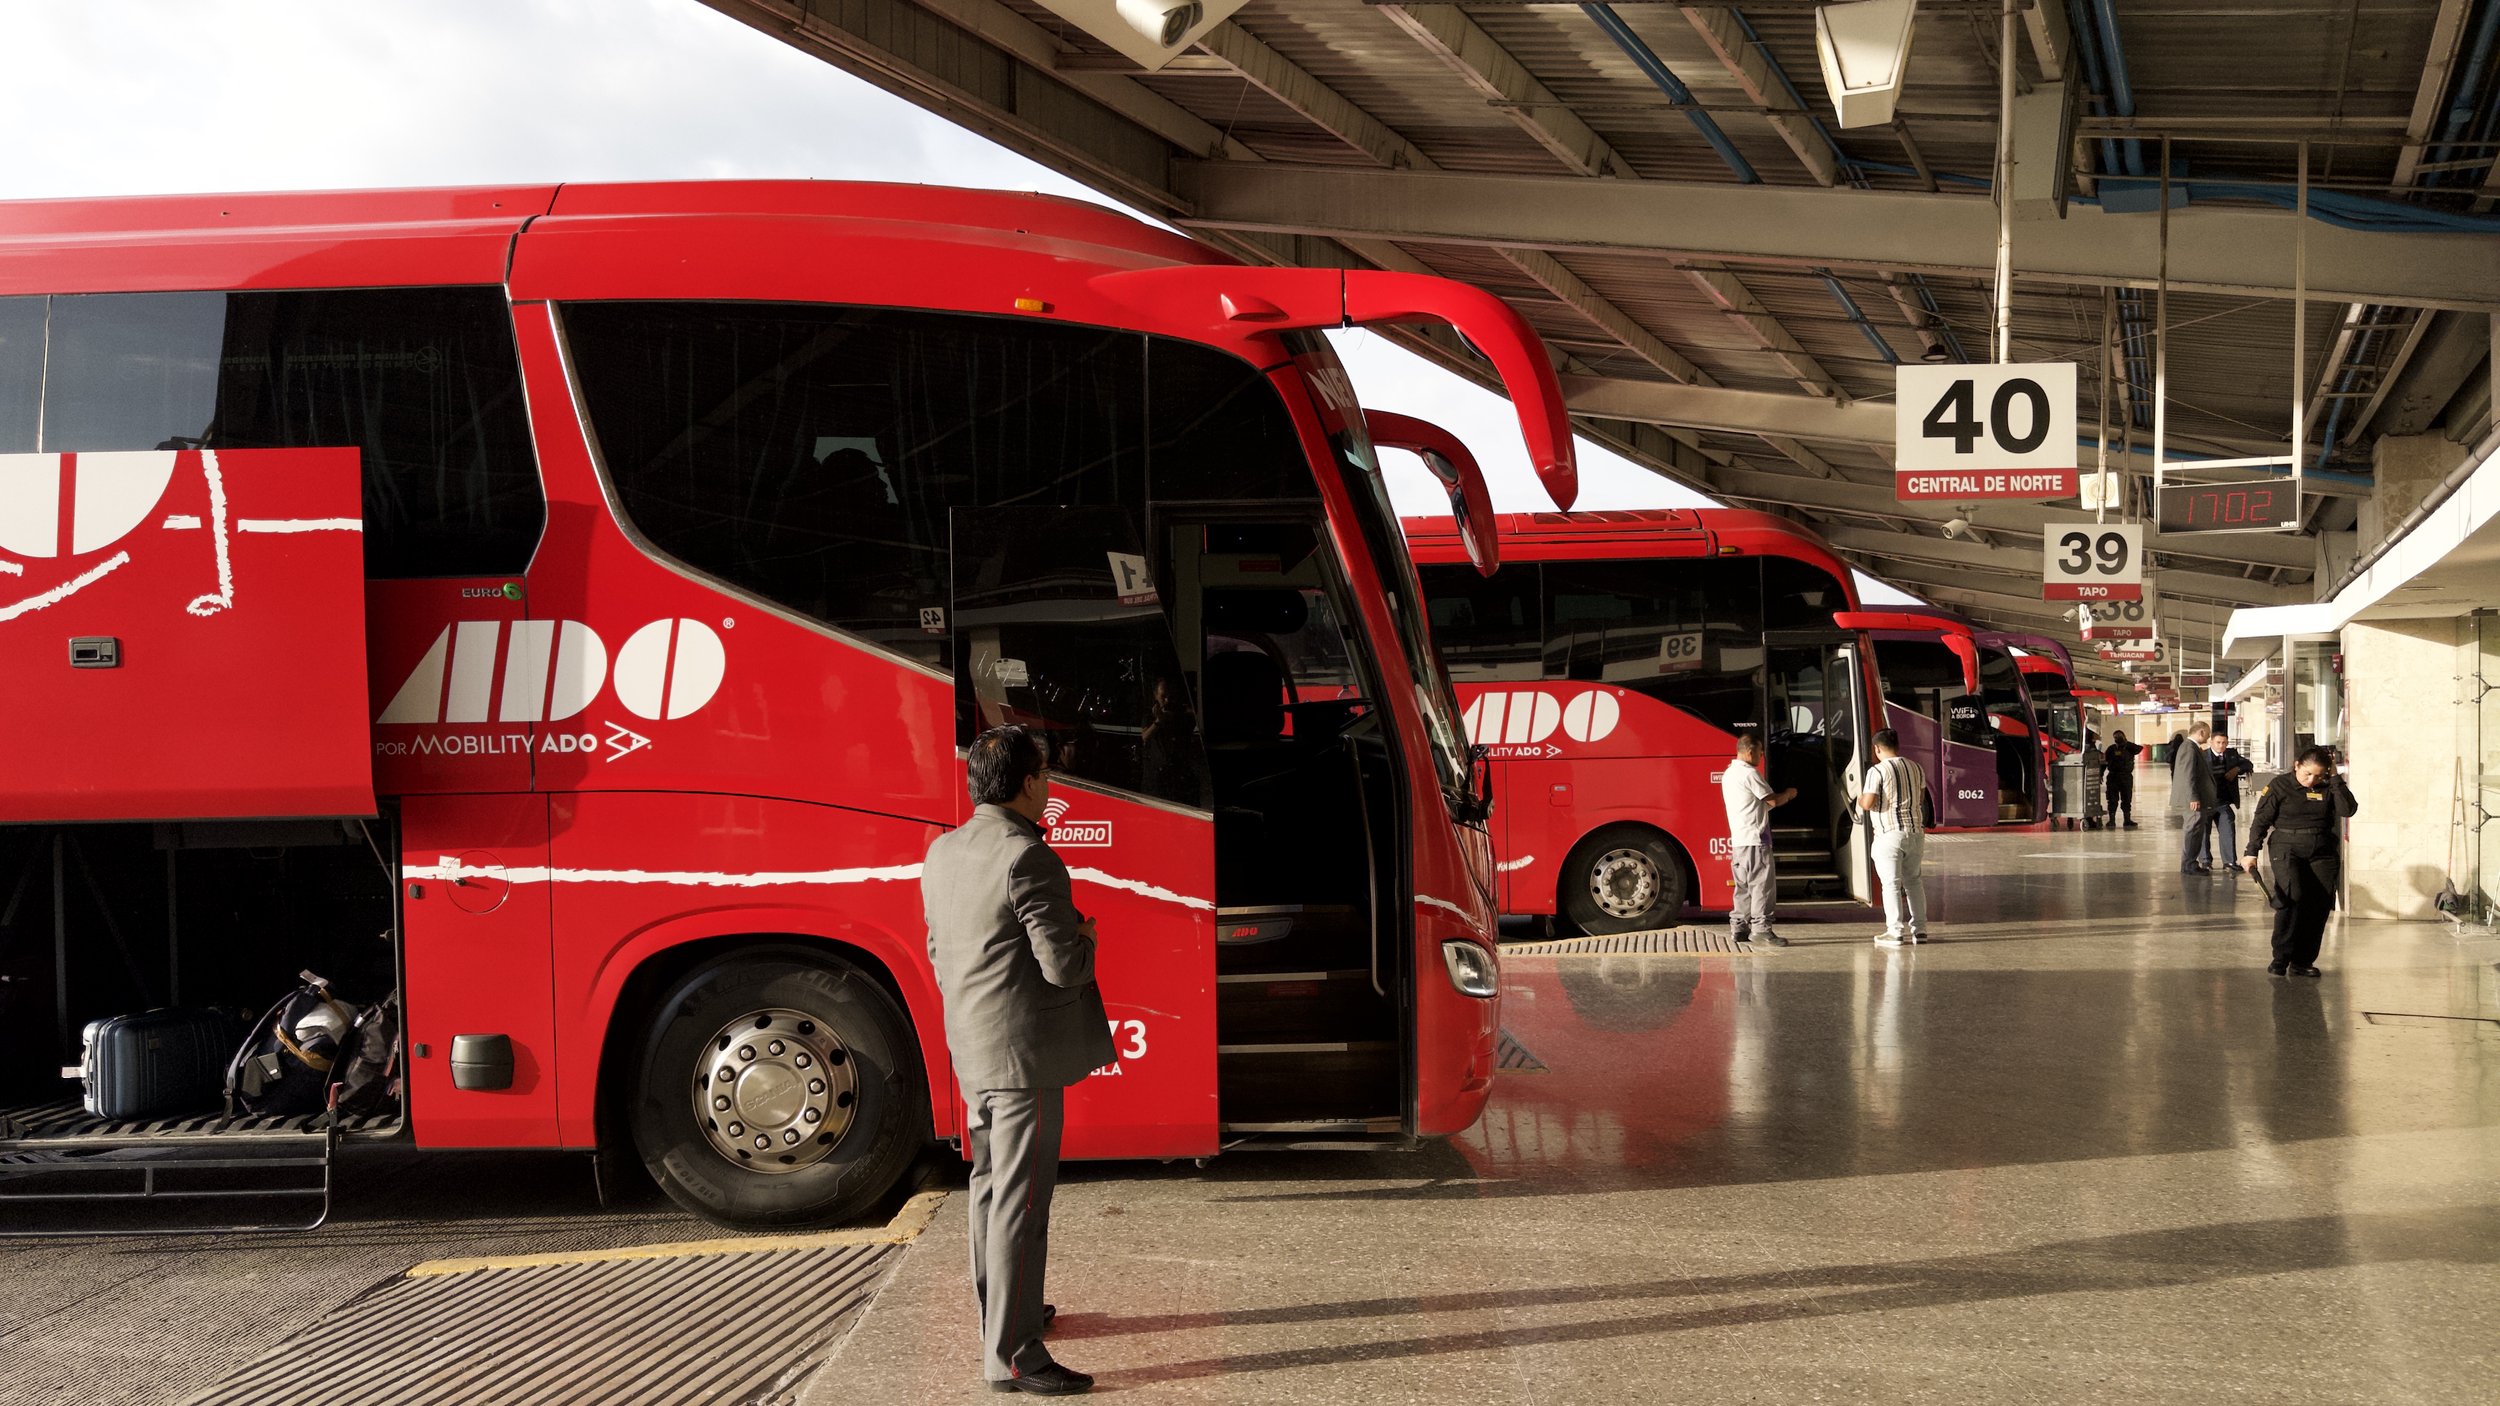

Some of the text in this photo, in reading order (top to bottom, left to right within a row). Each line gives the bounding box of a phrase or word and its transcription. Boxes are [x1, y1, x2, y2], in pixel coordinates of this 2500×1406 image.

[1922, 377, 2051, 454] 40
[1907, 474, 2062, 494] CENTRAL DE NORTE
[2058, 530, 2129, 576] 39
[2077, 586, 2108, 597] TAPO
[375, 617, 726, 724] ADO
[376, 733, 598, 756] POR MOBILITY ADO
[1515, 746, 1541, 756] ADO
[1958, 789, 1985, 800] 8062
[1051, 827, 1106, 842] BORDO
